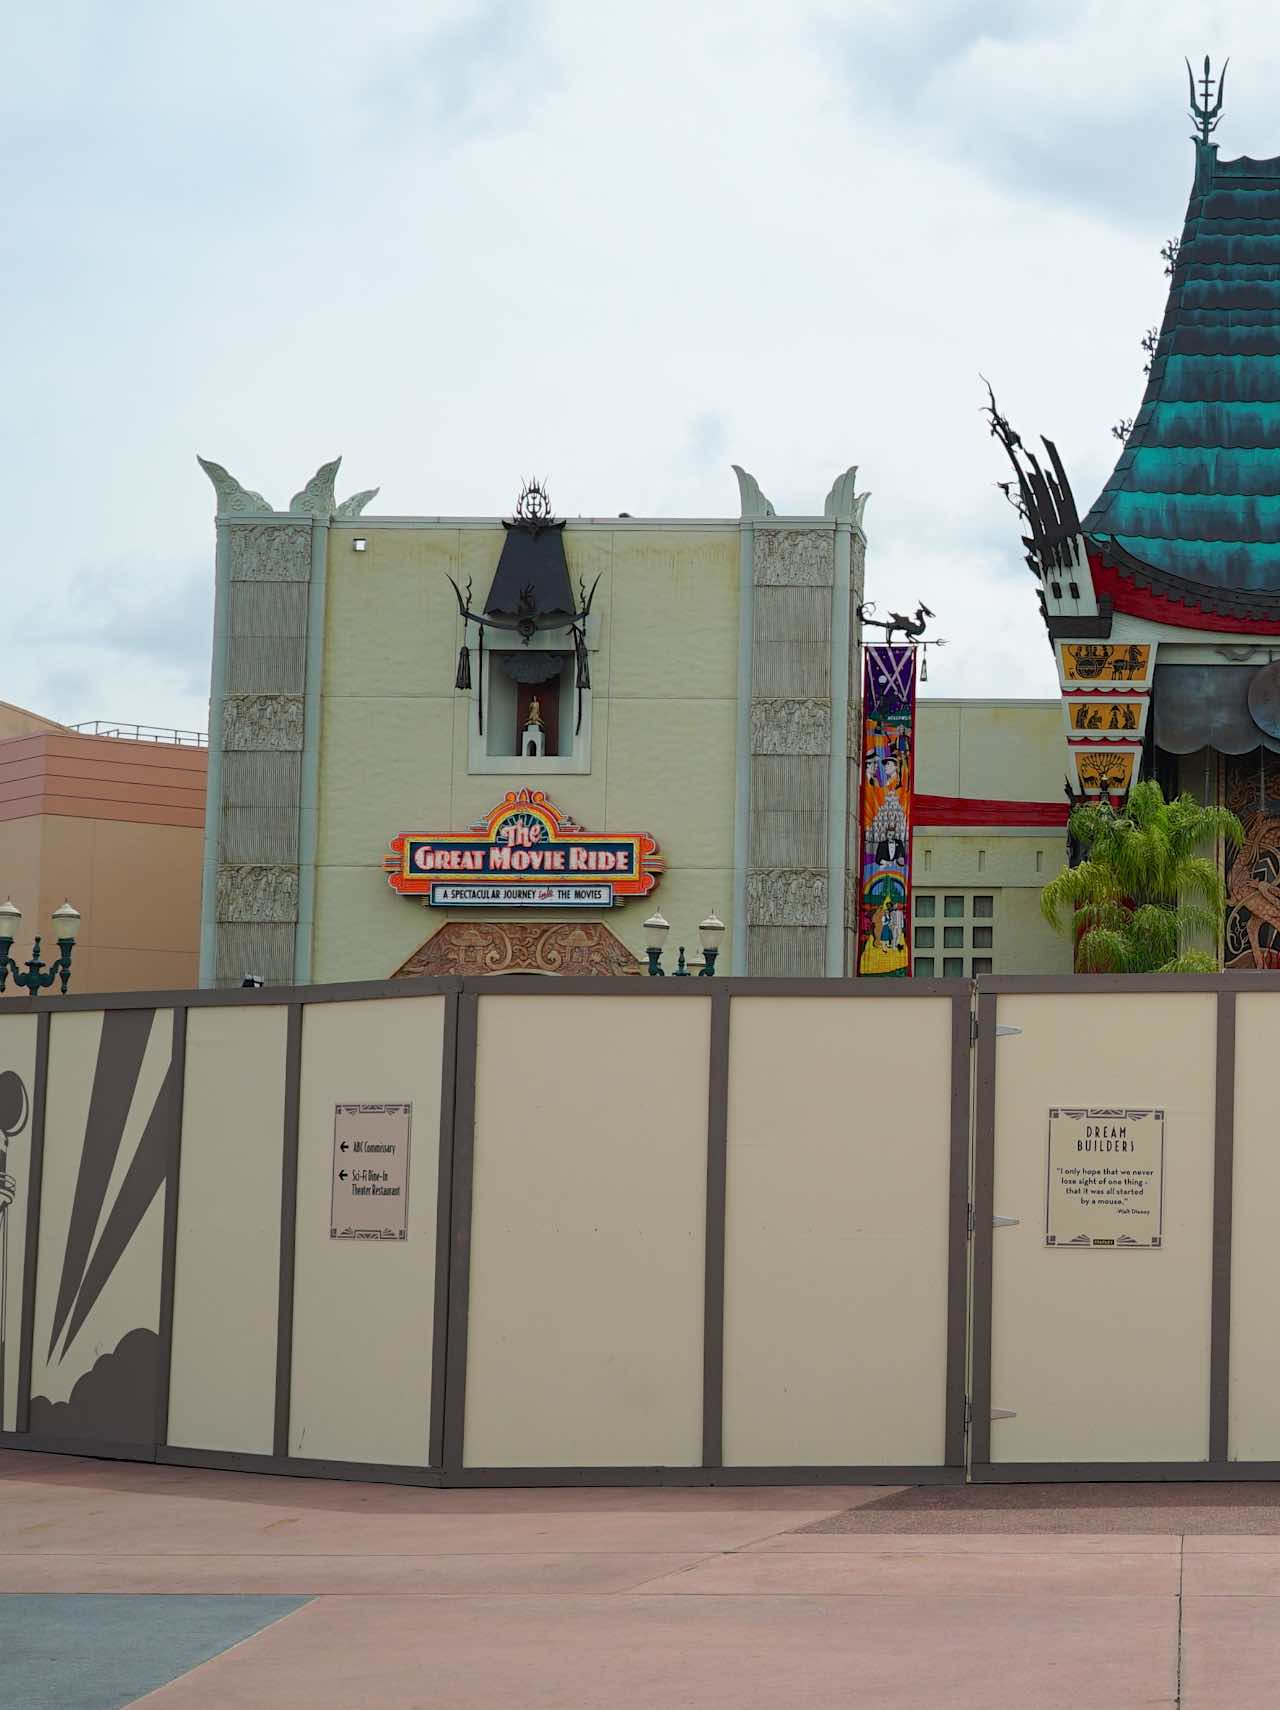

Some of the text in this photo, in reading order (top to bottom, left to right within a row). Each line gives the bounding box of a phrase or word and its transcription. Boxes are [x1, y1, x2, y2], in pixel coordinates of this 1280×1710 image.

[501, 819, 541, 848] The
[414, 846, 629, 871] GREAT MOVIE RIDE
[443, 889, 448, 899] A
[451, 889, 500, 899] SPECTACULAR
[503, 890, 536, 899] JOURNEY
[557, 889, 570, 899] THE
[574, 889, 602, 899] MOVIES
[1086, 1126, 1126, 1138] DREAM
[353, 1141, 363, 1153] ABC
[1077, 1140, 1135, 1152] BUILDERS
[1065, 1168, 1080, 1177] only
[1082, 1168, 1101, 1177] hope
[1079, 1178, 1096, 1186] sight
[1124, 1178, 1143, 1187] thing
[352, 1184, 371, 1196] Theater
